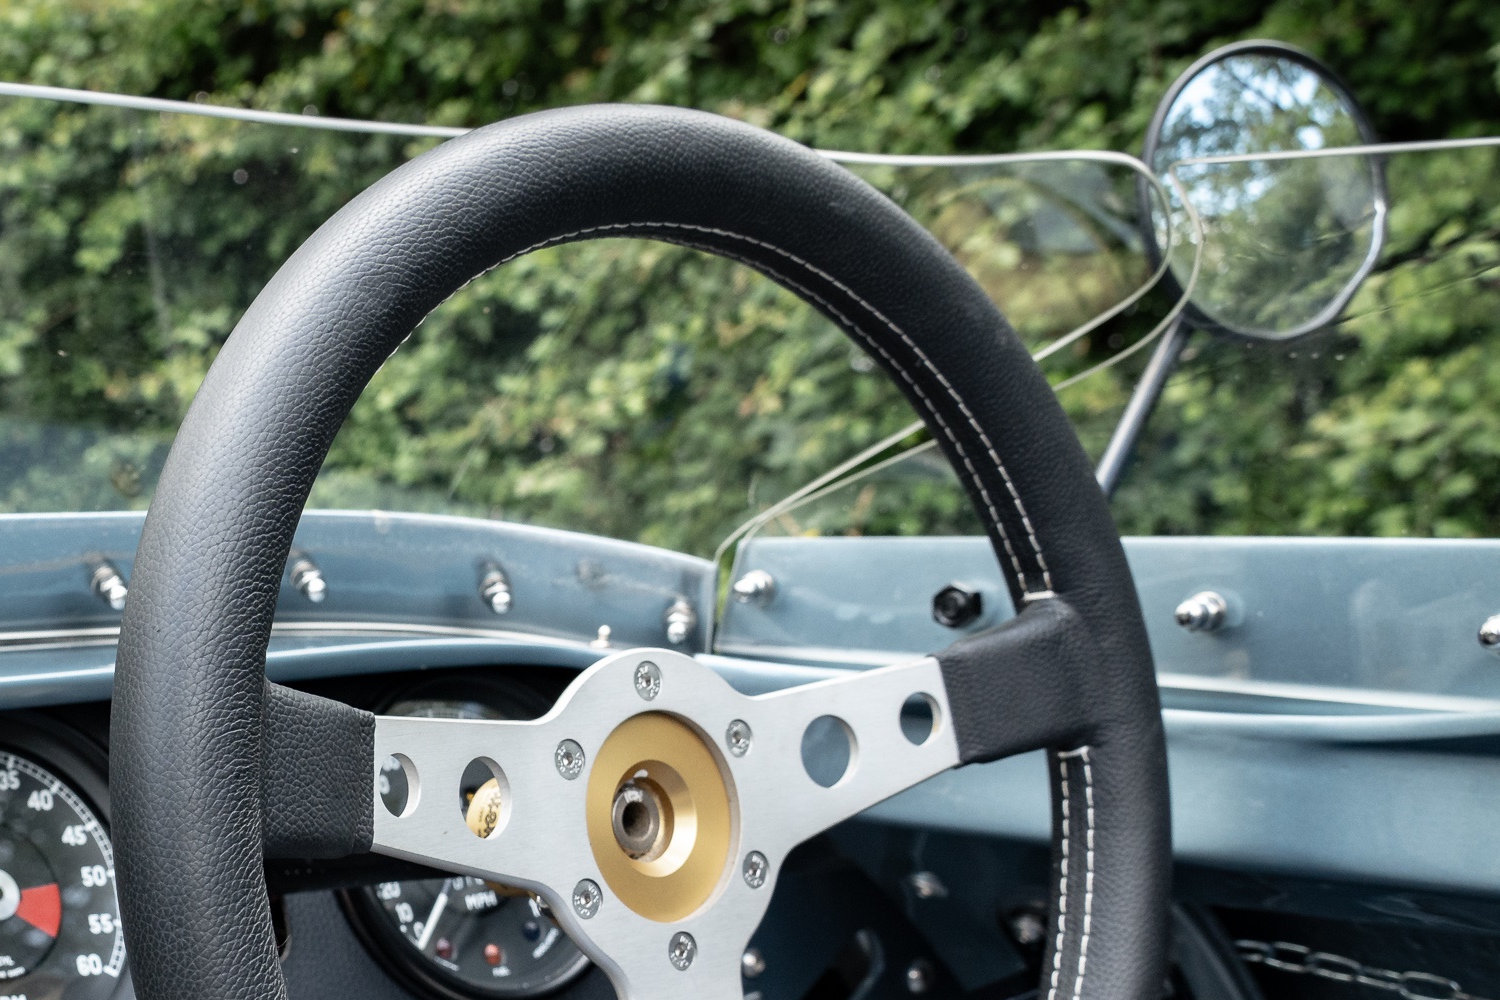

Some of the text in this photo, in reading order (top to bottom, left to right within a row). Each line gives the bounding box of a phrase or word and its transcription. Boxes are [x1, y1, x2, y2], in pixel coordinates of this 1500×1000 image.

[27, 789, 53, 811] 40
[61, 825, 88, 846] 45
[81, 865, 107, 887] 50
[88, 913, 114, 934] 55
[76, 953, 103, 976] 60
